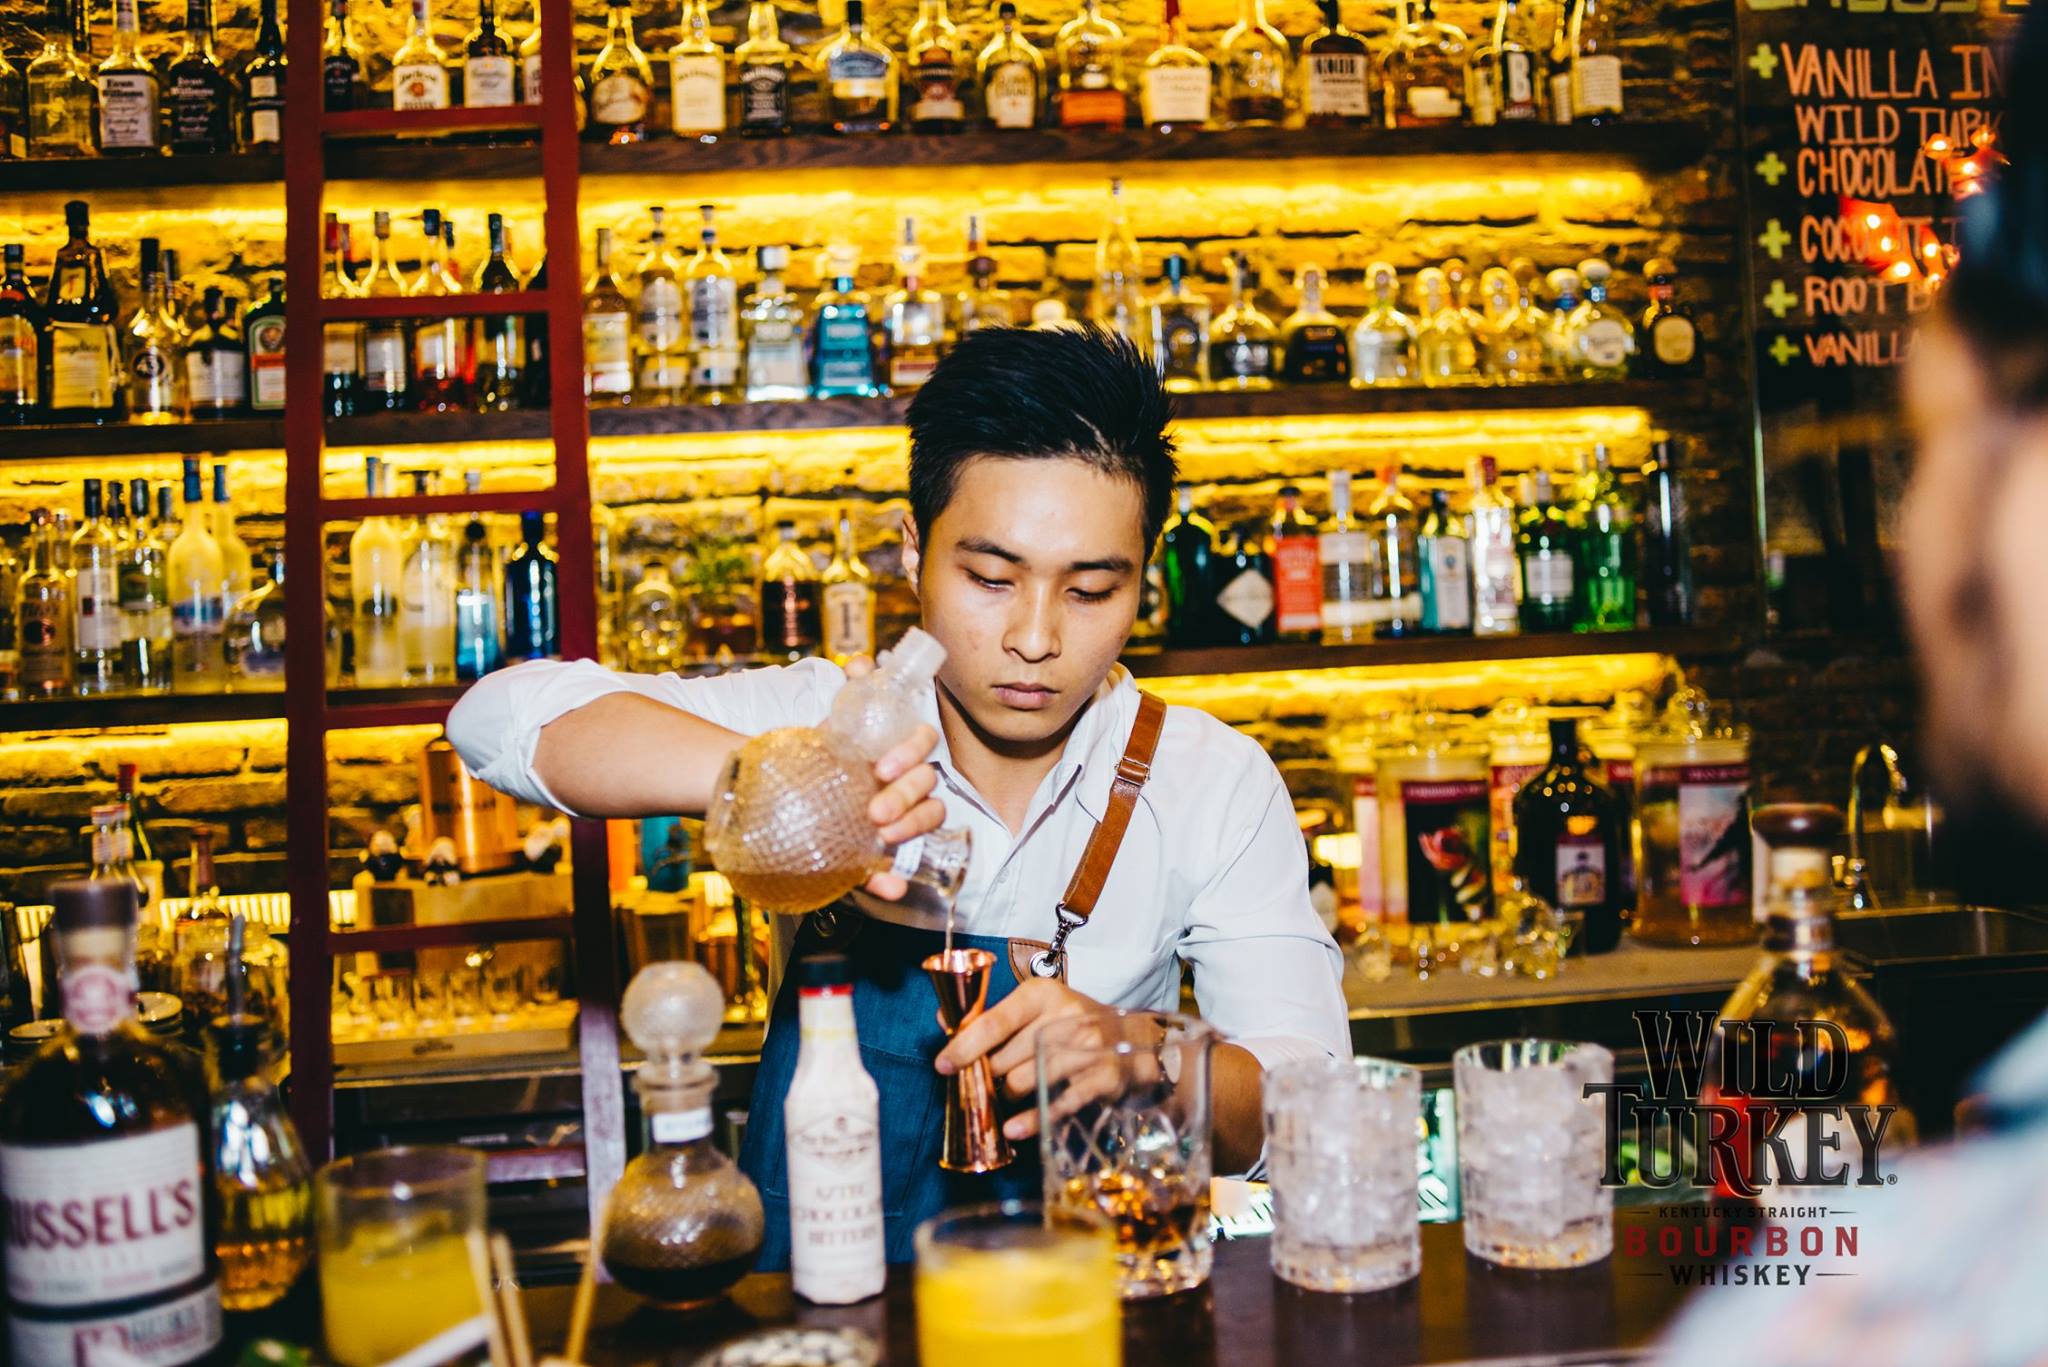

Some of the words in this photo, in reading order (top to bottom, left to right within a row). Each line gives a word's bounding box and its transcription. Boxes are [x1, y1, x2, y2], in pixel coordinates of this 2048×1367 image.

[1780, 42, 1938, 99] VANILLA
[1795, 105, 1900, 146] WILD
[1797, 148, 1966, 198] CHOCOLAT
[1803, 276, 1890, 317] ROOT
[1804, 329, 1908, 368] VANILL
